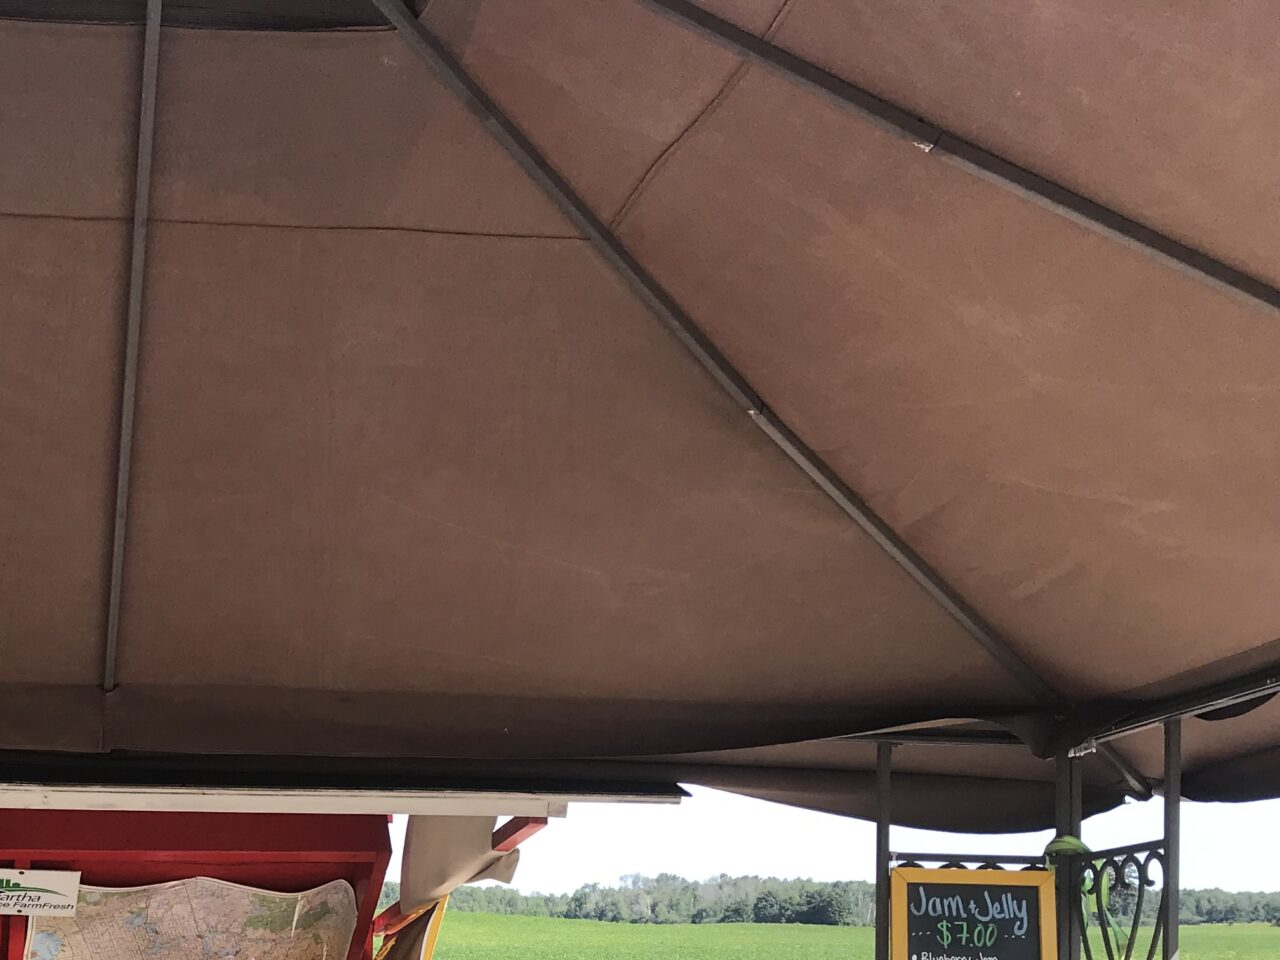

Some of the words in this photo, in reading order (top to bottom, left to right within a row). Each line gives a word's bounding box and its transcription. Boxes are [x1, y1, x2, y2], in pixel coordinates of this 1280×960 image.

[13, 902, 74, 910] FarmFresh
[910, 886, 967, 918] Jam
[975, 890, 1028, 935] Jelly
[936, 919, 998, 949] $7.00
